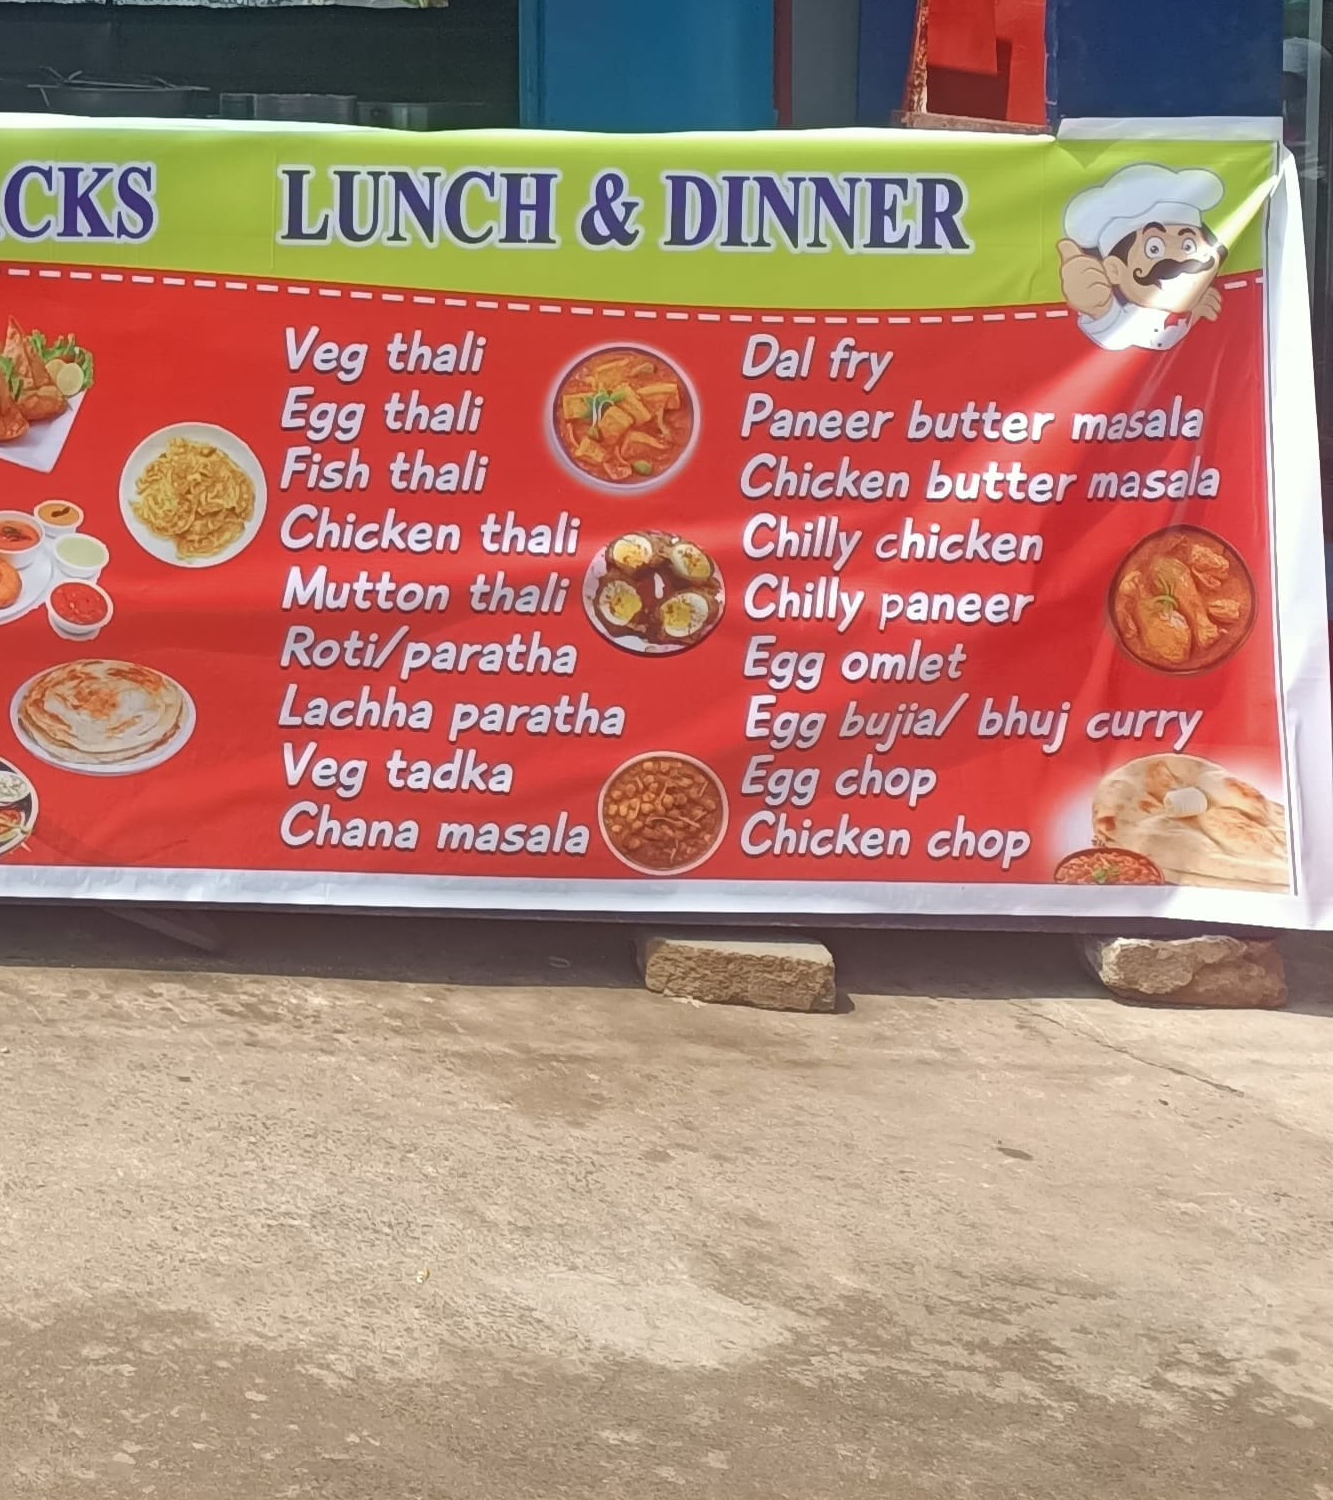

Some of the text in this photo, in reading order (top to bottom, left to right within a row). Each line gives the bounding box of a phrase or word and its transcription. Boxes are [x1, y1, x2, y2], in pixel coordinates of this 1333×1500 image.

[279, 167, 971, 252] LUNCH & DINNER
[284, 326, 487, 382] Veg thali
[741, 333, 893, 391] Dal fry
[281, 387, 484, 441] Egg thali
[740, 392, 1205, 443] Paneer butter masala
[279, 446, 489, 492] Fish thali
[740, 453, 1221, 502] Chicken butter masala
[280, 504, 580, 555] Chicken thali
[742, 512, 1044, 571] Chilly chicken
[281, 565, 570, 614] Mutton thali
[743, 573, 1035, 632] Chilly paneer
[279, 626, 578, 680] Roti/paratha
[743, 635, 968, 690] Egg omlet
[279, 683, 626, 741] Lachha paratha
[745, 692, 1203, 754] Egg bujia/ bhuj curry
[282, 742, 514, 798] Veg tadka
[740, 754, 937, 807] Egg chop
[280, 801, 591, 855] Chana masala
[740, 810, 1031, 869] Chicken chop
